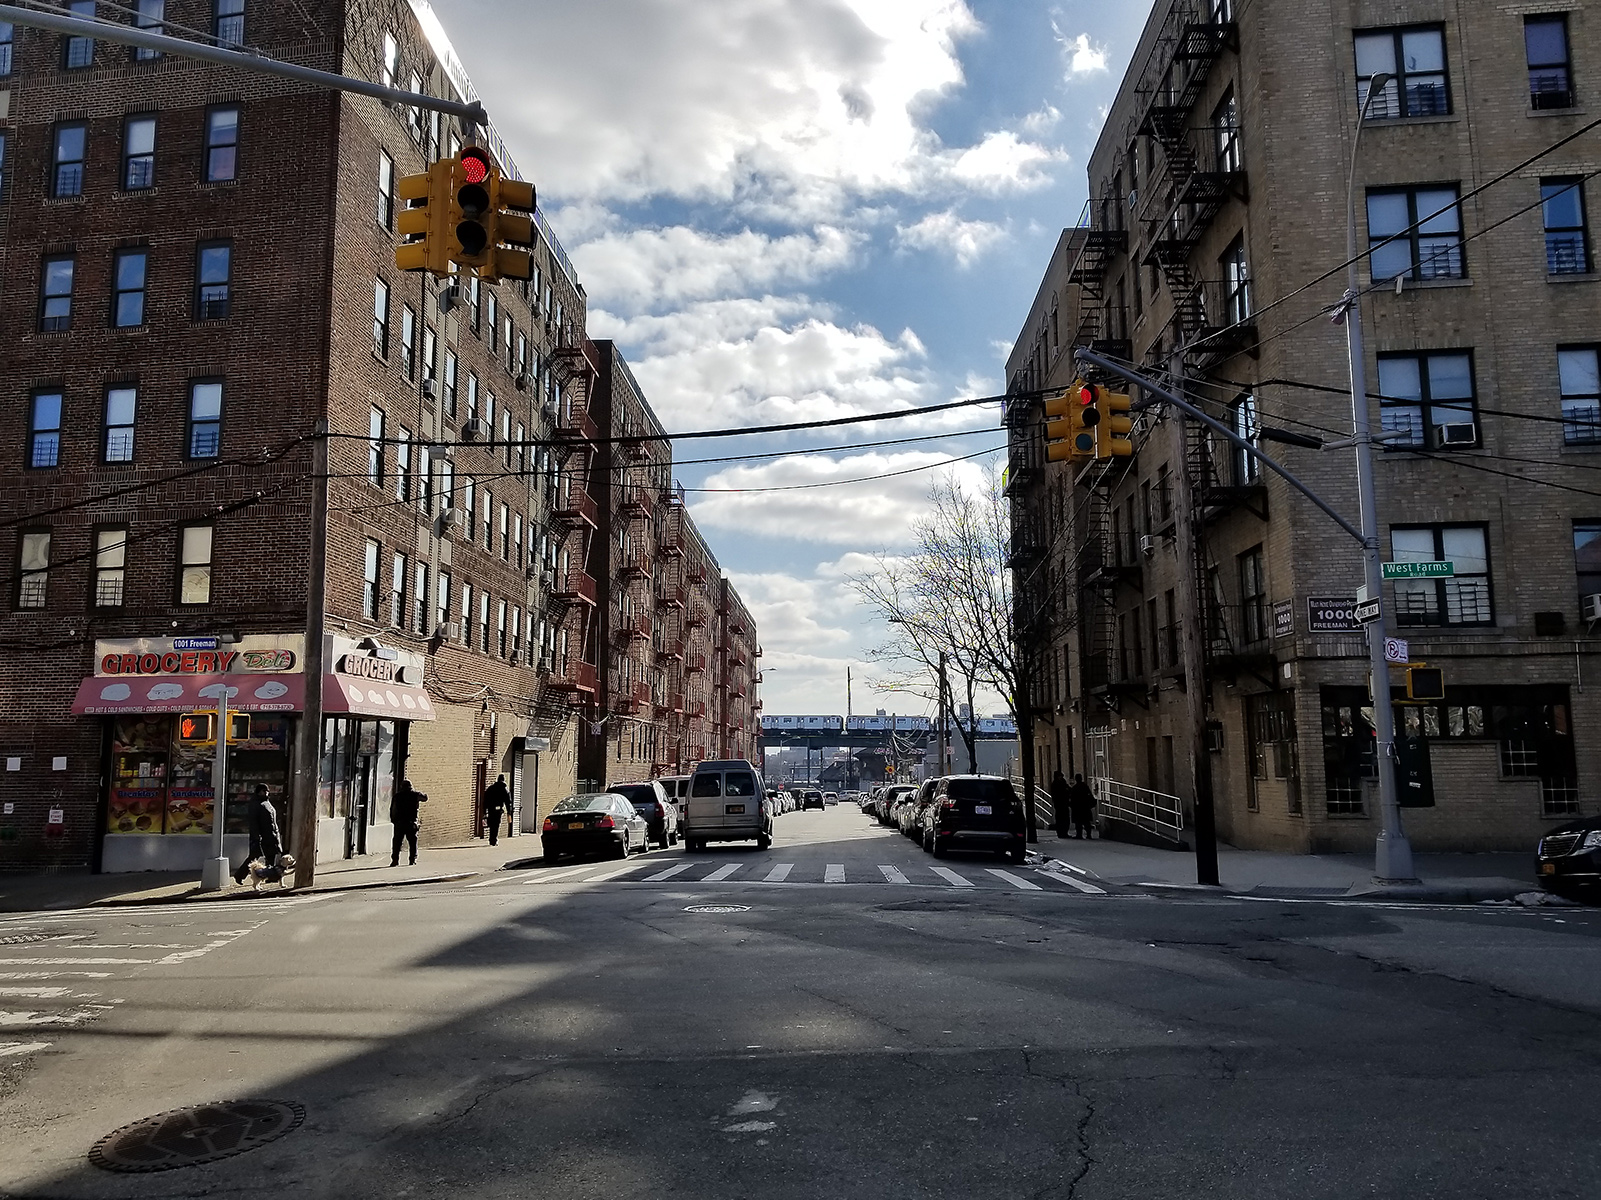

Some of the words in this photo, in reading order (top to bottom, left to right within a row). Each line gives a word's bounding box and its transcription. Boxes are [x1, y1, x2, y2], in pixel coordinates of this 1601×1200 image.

[1386, 563, 1412, 573] West
[1416, 563, 1448, 571] Farms
[1317, 609, 1353, 620] 1000
[1357, 608, 1366, 618] ONE
[1367, 605, 1377, 615] WAY
[174, 640, 189, 648] 1001
[189, 639, 216, 647] Freeman
[101, 651, 235, 674] GROCERY
[246, 653, 287, 668] Deli
[344, 654, 399, 682] GROCERY
[117, 790, 159, 798] Breakfast
[171, 789, 215, 797] Sandwich
